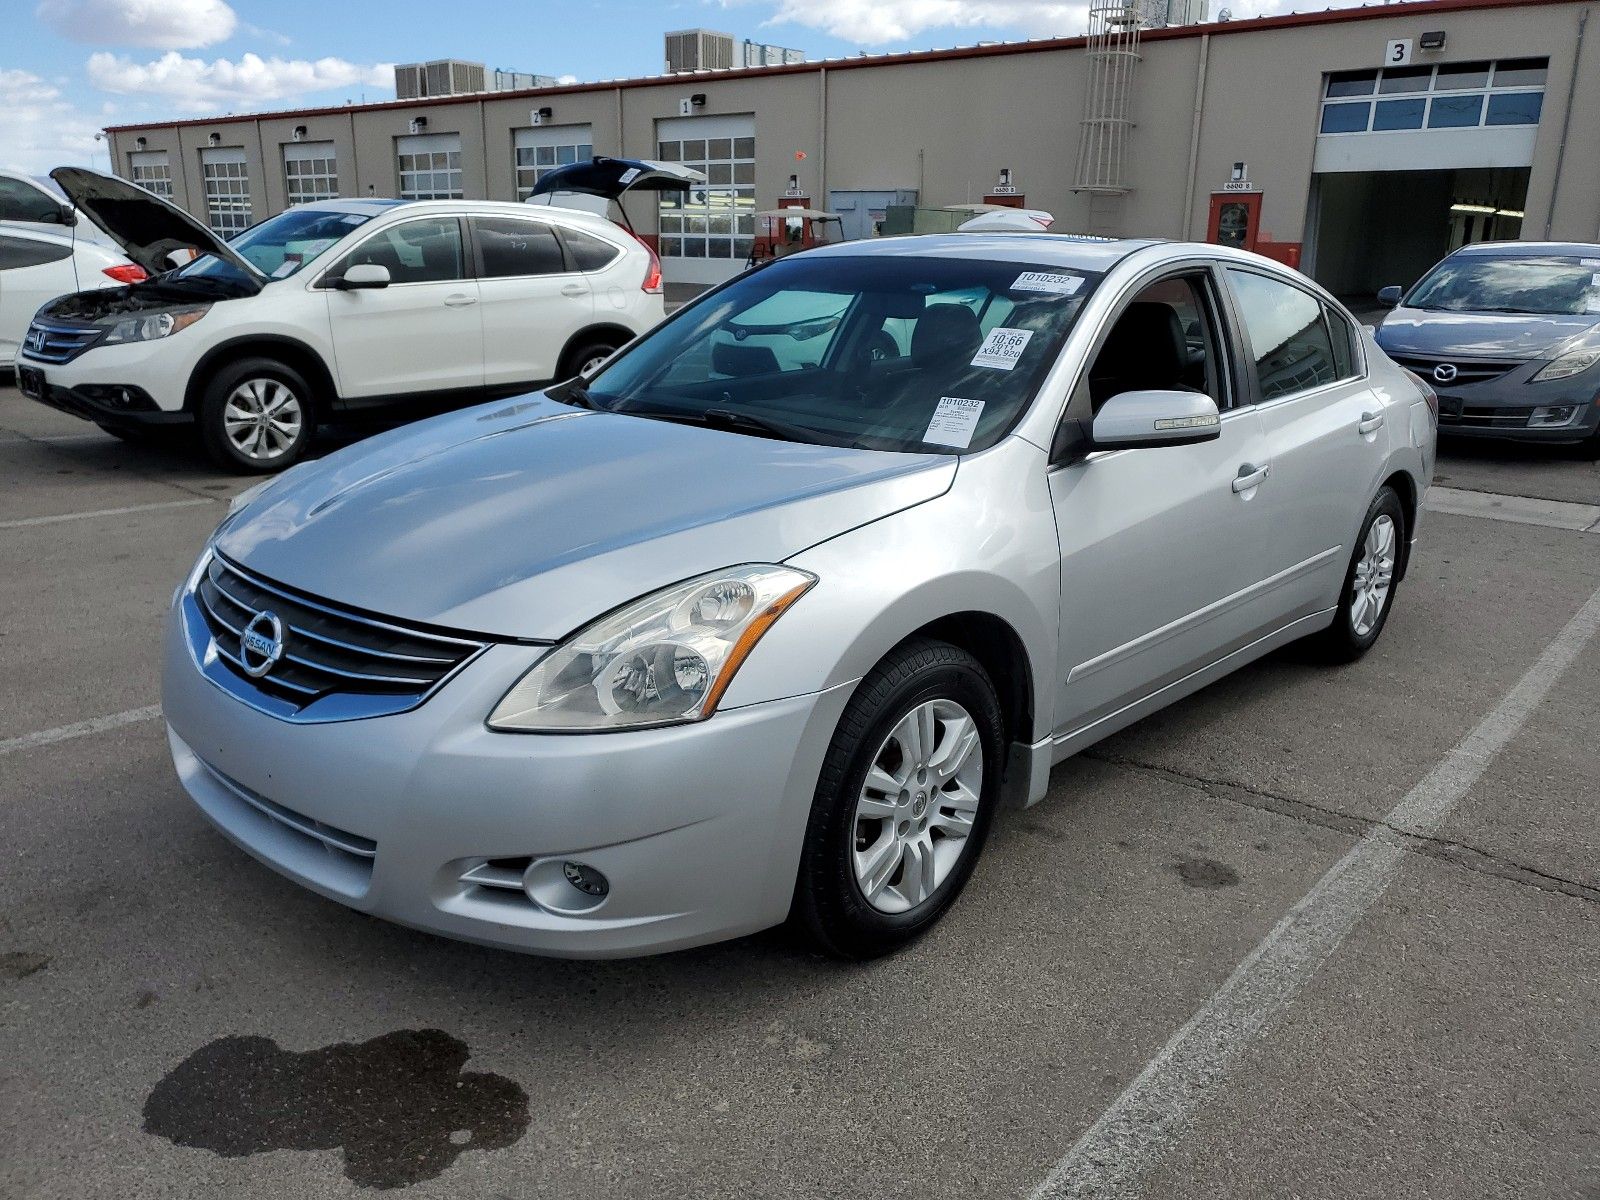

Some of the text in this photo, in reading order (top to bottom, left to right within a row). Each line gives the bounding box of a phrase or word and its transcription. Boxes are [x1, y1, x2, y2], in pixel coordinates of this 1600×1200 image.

[1392, 43, 1405, 62] 3
[683, 101, 688, 113] 1
[534, 112, 539, 123] 2
[1021, 273, 1070, 284] 1010232
[991, 334, 1024, 346] 10:66
[941, 398, 980, 408] 1010232
